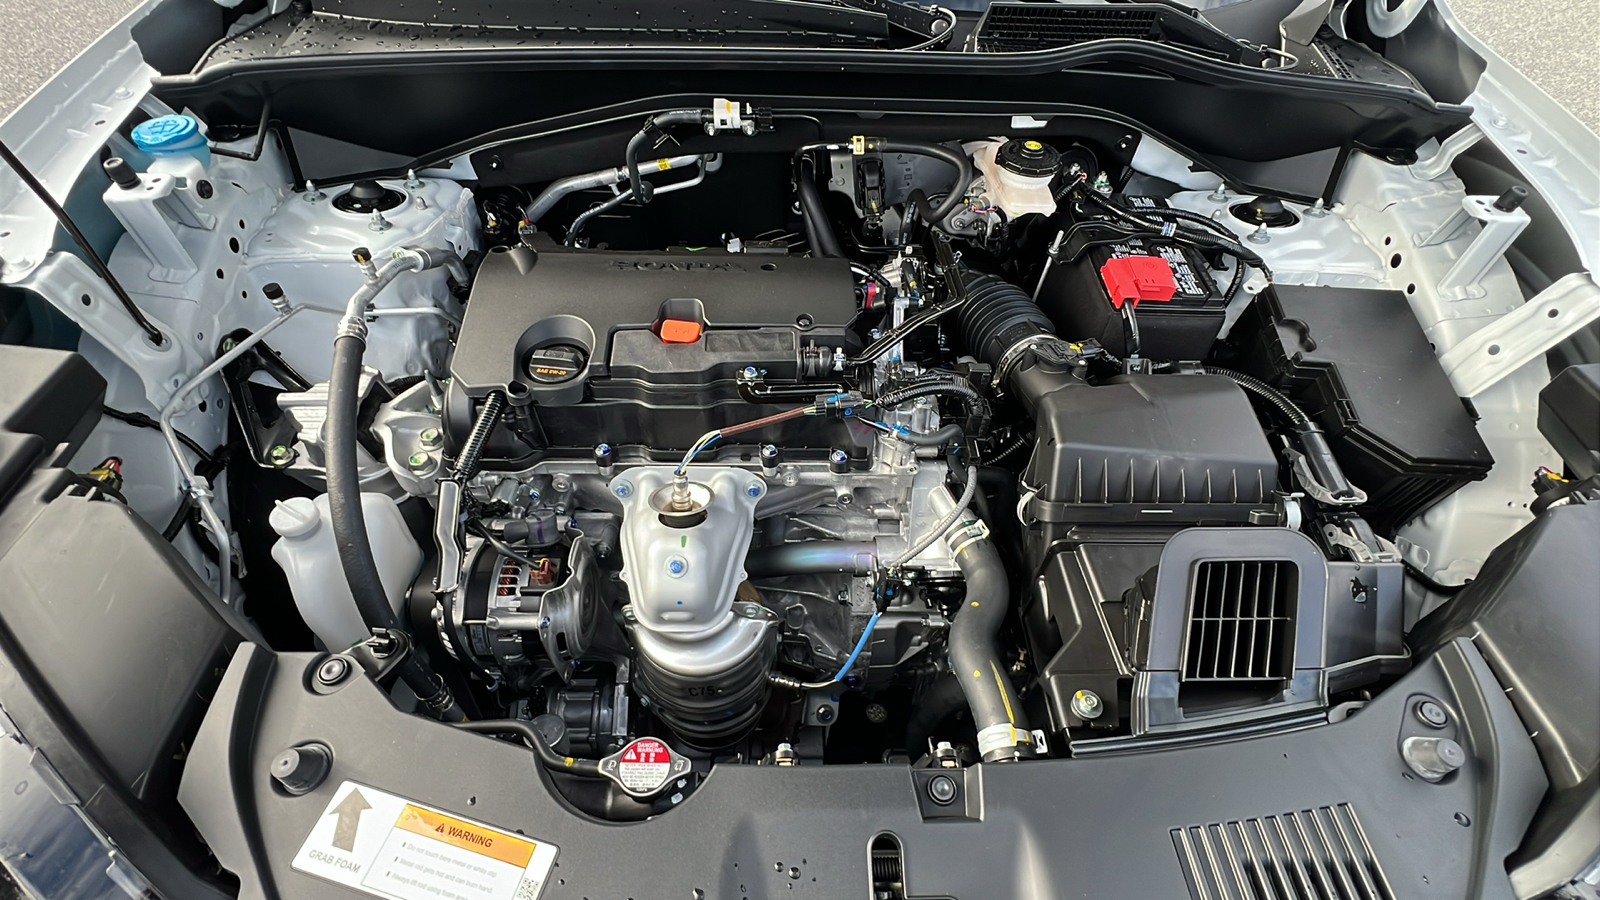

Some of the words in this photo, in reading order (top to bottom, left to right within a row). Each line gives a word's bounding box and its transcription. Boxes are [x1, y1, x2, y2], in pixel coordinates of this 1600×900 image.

[448, 825, 494, 848] WARNING
[308, 849, 335, 865] GRAB
[334, 858, 361, 873] FOAM
